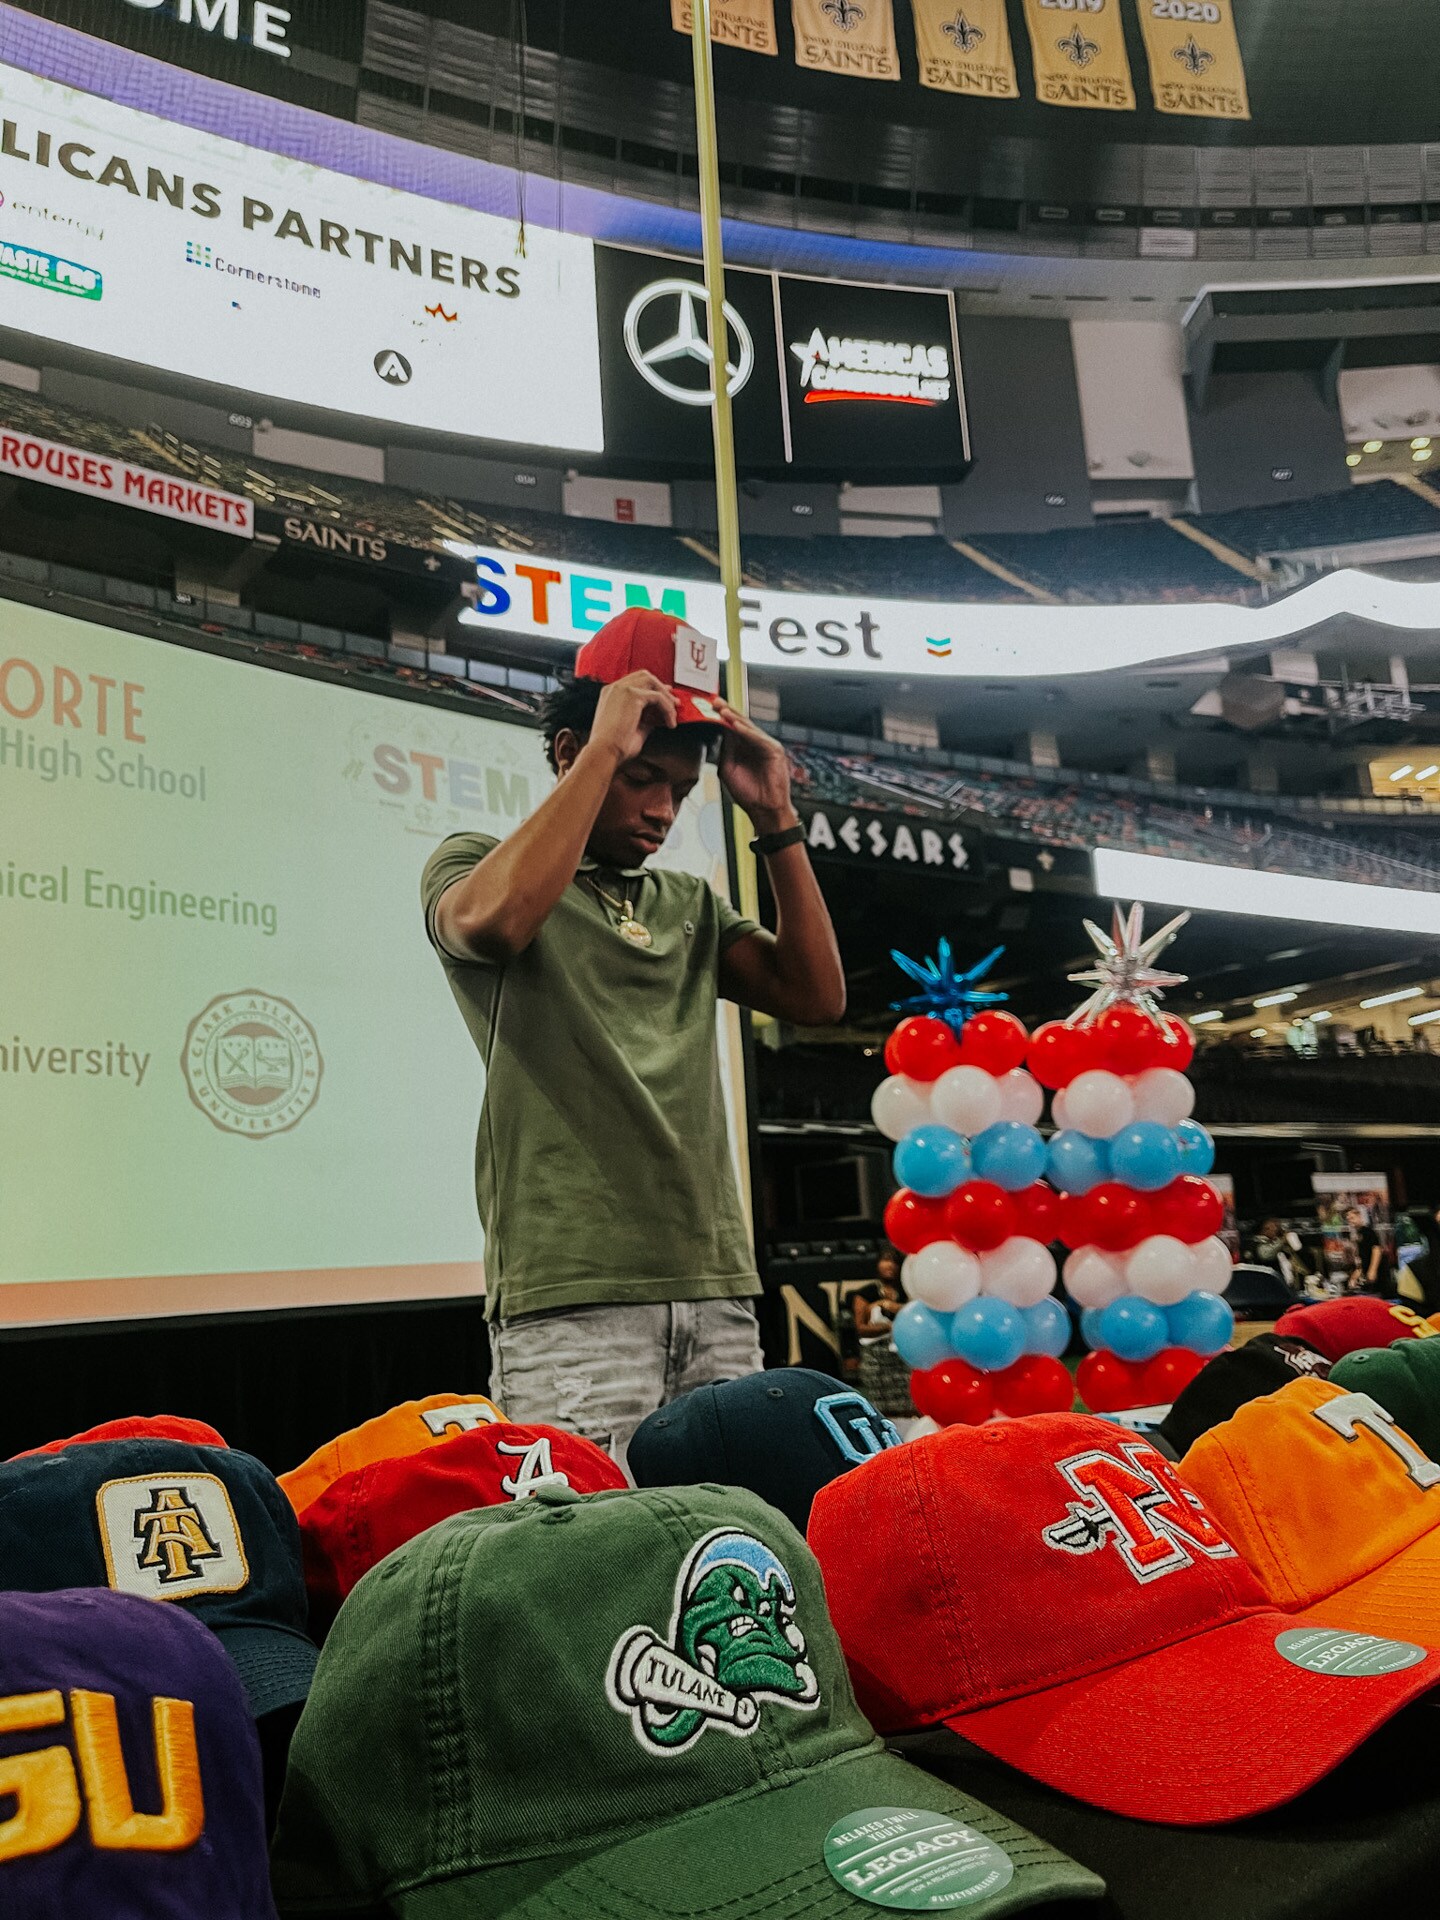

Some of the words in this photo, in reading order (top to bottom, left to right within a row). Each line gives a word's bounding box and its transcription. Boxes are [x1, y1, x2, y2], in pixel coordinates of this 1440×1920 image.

[123, 0, 291, 58] ME
[681, 11, 769, 49] SINTS
[1152, 1, 1220, 23] 2020
[805, 45, 892, 74] SAINTS
[926, 66, 1010, 94] SAINTS
[1043, 81, 1127, 105] SAINTS
[1161, 90, 1243, 114] SAINTS
[2, 119, 222, 219] LICANS
[242, 195, 522, 298] PARTNERS
[215, 257, 321, 299] Cornerstone
[2, 436, 114, 489] ROUSES
[124, 470, 248, 527] MARKETS
[284, 517, 387, 561] SAINTS
[0, 726, 82, 782] High
[95, 747, 206, 802] School
[373, 744, 531, 818] STEM
[808, 811, 969, 870] AESARS
[0, 861, 68, 904] ical
[84, 868, 278, 936] Engineering
[1310, 1391, 1440, 1492] T
[497, 1437, 569, 1501] A
[1306, 1635, 1384, 1669] LEGACY
[645, 1657, 727, 1709] TULANE
[832, 1820, 884, 1847] RELAXED
[883, 1811, 920, 1833] TWILL
[867, 1823, 907, 1843] YOUTH
[844, 1829, 977, 1888] LEGACY
